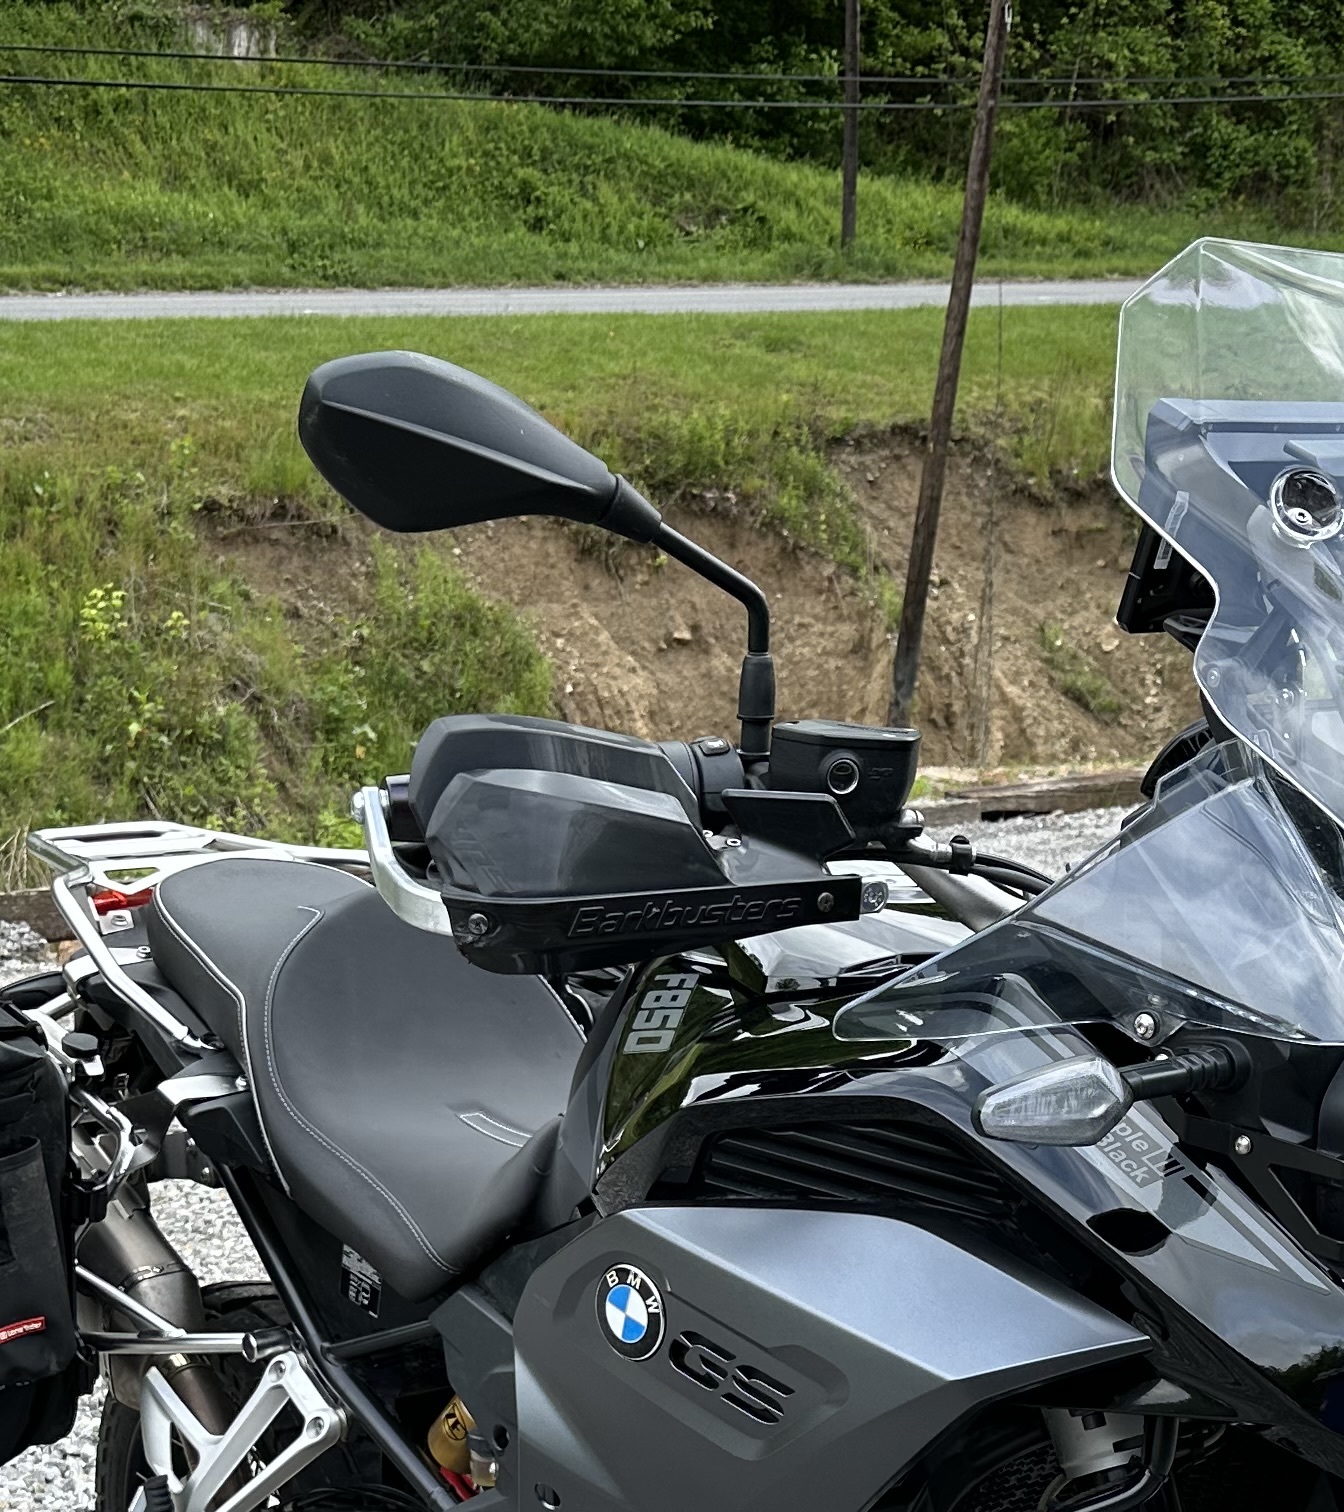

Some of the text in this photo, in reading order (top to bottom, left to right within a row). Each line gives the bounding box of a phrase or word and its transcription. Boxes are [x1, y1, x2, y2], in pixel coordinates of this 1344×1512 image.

[567, 894, 804, 938] Barkbusters
[623, 973, 701, 1056] F850
[605, 1269, 661, 1314] BMW
[668, 1330, 796, 1426] GS
